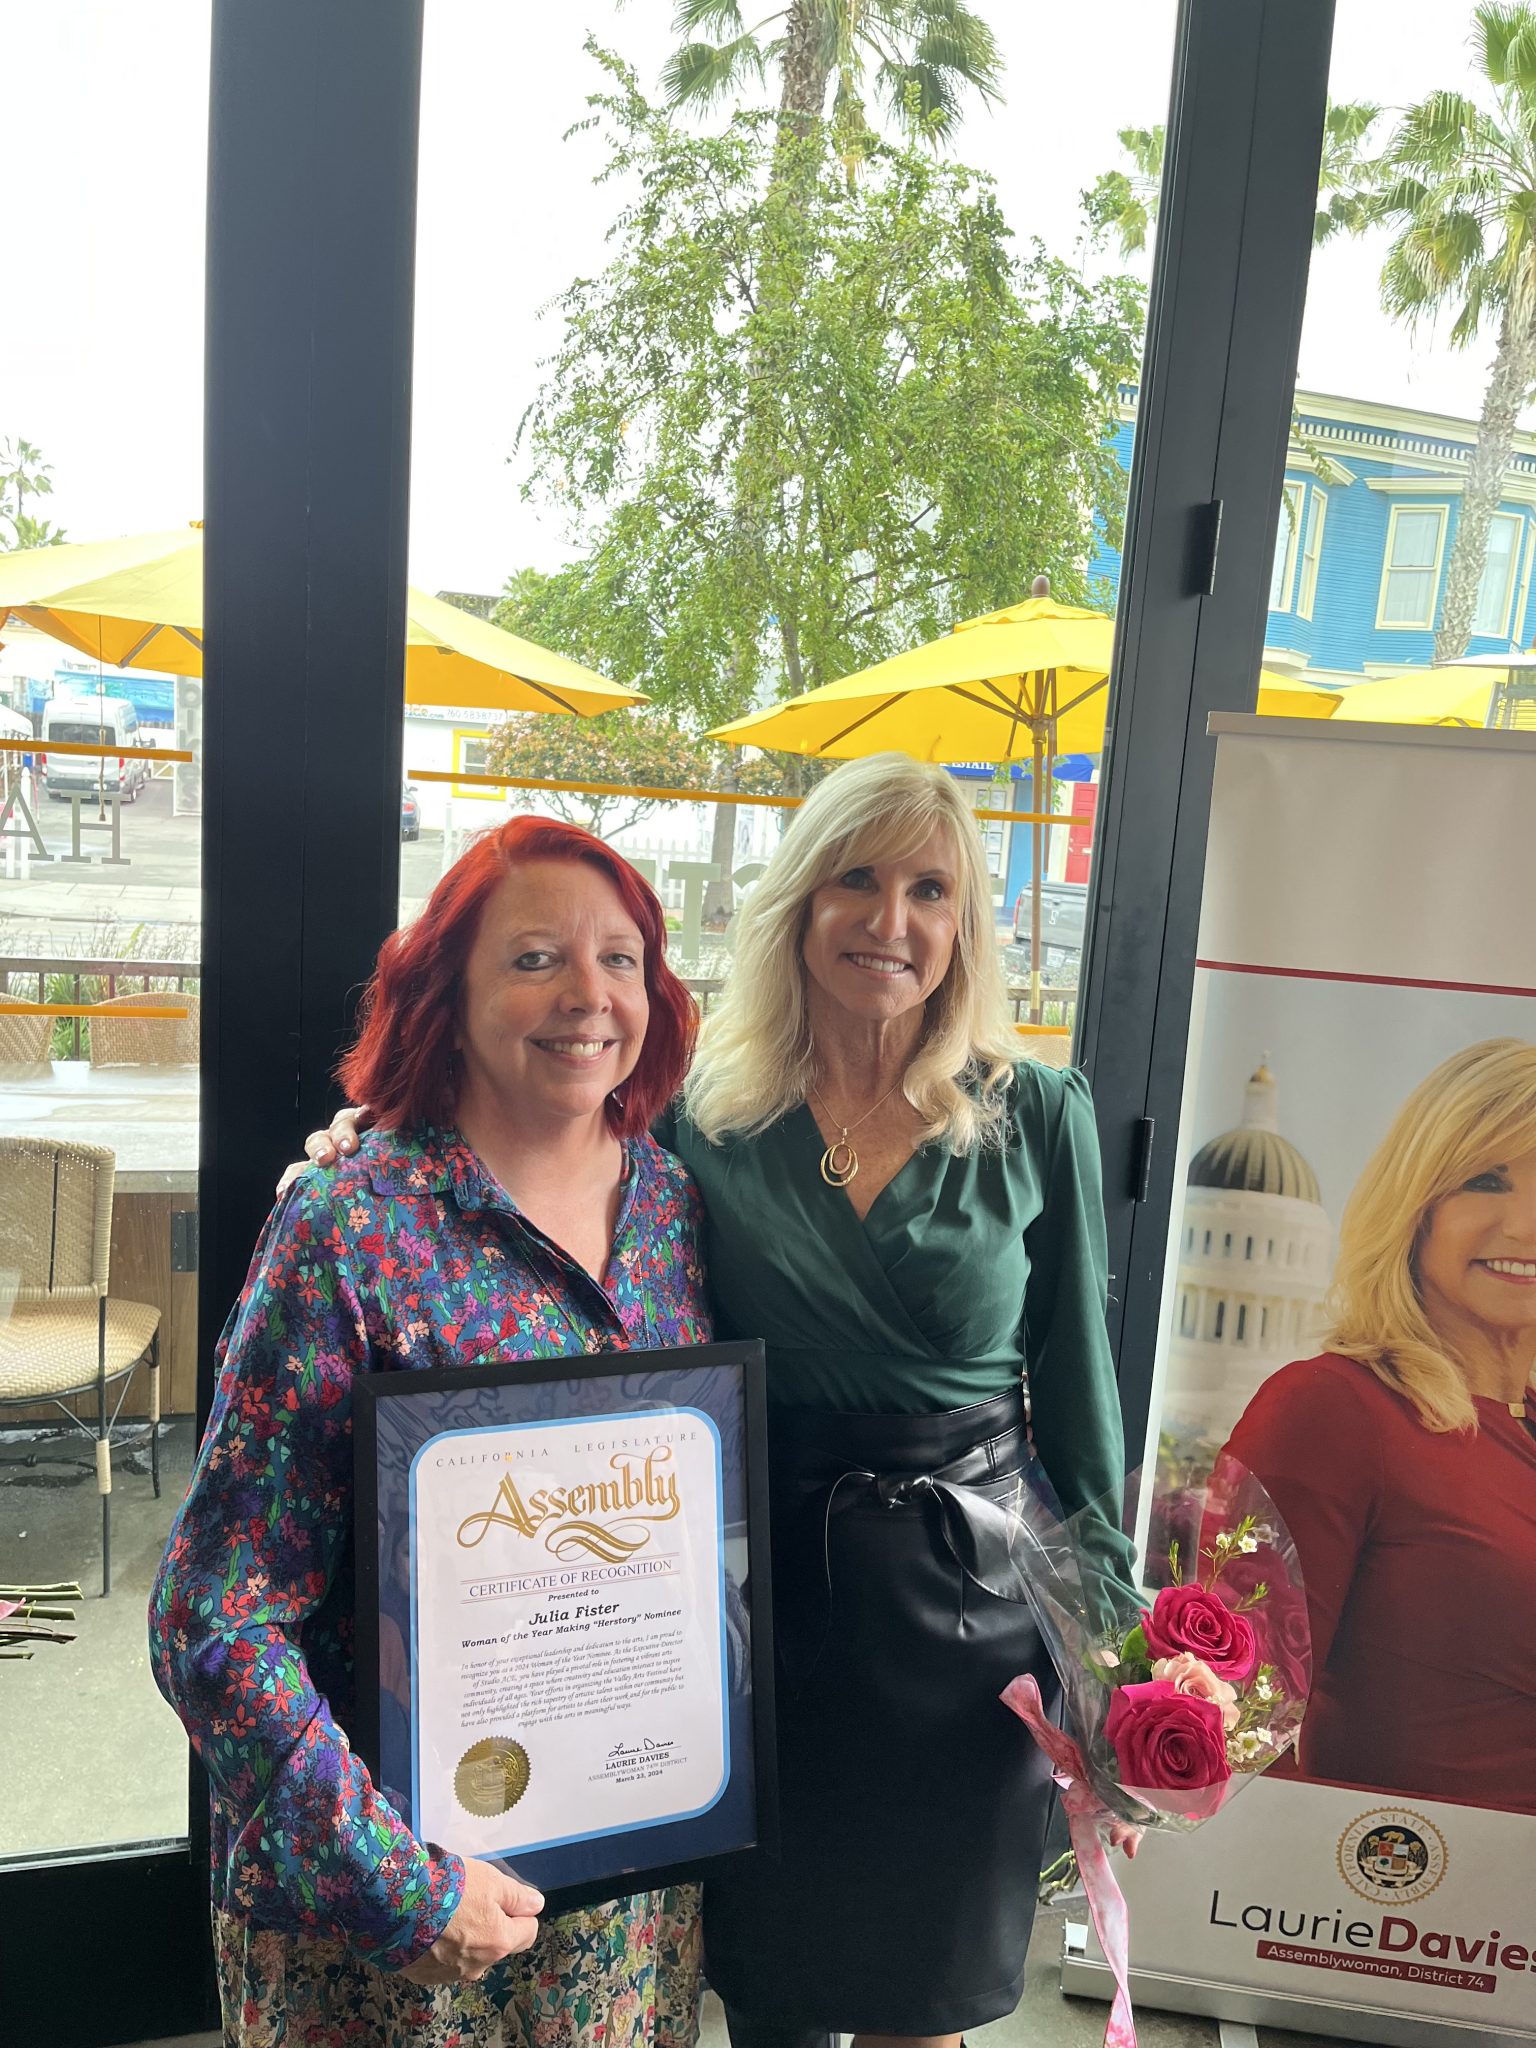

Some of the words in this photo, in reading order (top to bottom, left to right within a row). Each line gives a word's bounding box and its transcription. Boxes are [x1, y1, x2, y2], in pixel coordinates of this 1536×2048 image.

[575, 1432, 696, 1452] LEGISLATURE
[457, 1445, 681, 1563] Assembly
[470, 1575, 556, 1597] CERTIFICATE
[560, 1572, 577, 1585] OF
[582, 1559, 672, 1582] RECOGNITION
[548, 1590, 588, 1601] Presented
[462, 1638, 497, 1648] Woman
[501, 1633, 511, 1644] of
[513, 1632, 529, 1640] the
[532, 1629, 553, 1637] Year
[556, 1623, 590, 1634] Making
[644, 1610, 682, 1620] Nominee
[529, 1609, 569, 1625] Julia
[575, 1604, 619, 1618] Fister
[461, 1670, 488, 1680] recognize
[489, 1669, 500, 1677] you
[515, 1663, 529, 1671] 2024
[554, 1657, 562, 1666] of
[633, 1643, 659, 1652] Executive
[661, 1639, 683, 1647] Director
[488, 1658, 495, 1668] of
[496, 1658, 509, 1667] your
[544, 1647, 572, 1657] leadership
[573, 1644, 584, 1652] and
[585, 1641, 613, 1650] dedication
[660, 1630, 675, 1641] proud
[463, 1696, 496, 1707] individuals
[497, 1694, 504, 1704] of
[545, 1685, 564, 1696] efforts
[615, 1674, 631, 1682] Valley
[646, 1667, 668, 1677] Festival
[472, 1708, 485, 1716] only
[487, 1701, 519, 1715] highlighted
[531, 1698, 541, 1706] rich
[568, 1692, 575, 1701] of
[575, 1689, 595, 1698] artistic
[597, 1686, 613, 1694] talent
[615, 1683, 633, 1691] within
[645, 1676, 675, 1686] community
[473, 1679, 480, 1689] of
[520, 1673, 530, 1682] you
[545, 1665, 565, 1677] played
[529, 1680, 544, 1689] space
[564, 1672, 590, 1681] creativity
[604, 1665, 630, 1674] education
[490, 1711, 516, 1724] provided
[521, 1708, 547, 1719] platform
[547, 1705, 556, 1714] for
[557, 1702, 575, 1710] artists
[600, 1695, 614, 1703] their
[615, 1692, 629, 1700] work
[630, 1690, 641, 1698] and
[641, 1689, 650, 1698] for
[661, 1684, 677, 1695] public
[518, 1719, 537, 1728] engage
[539, 1714, 553, 1723] with
[588, 1765, 644, 1781] ASSEMBLYWOMAN
[660, 1757, 687, 1767] DISTRICT
[606, 1758, 636, 1770] LAURIE
[639, 1752, 669, 1764] DAVIES
[616, 1775, 634, 1783] March
[648, 1769, 663, 1777] 2024
[1380, 1813, 1428, 1834] STATE
[1343, 1824, 1380, 1897] CALIFORNIA
[1391, 1844, 1441, 1900] ASSEMBLY
[1267, 1945, 1403, 1977] Assemblywoman,
[1408, 1966, 1463, 1985] District
[1467, 1975, 1485, 1988] 74
